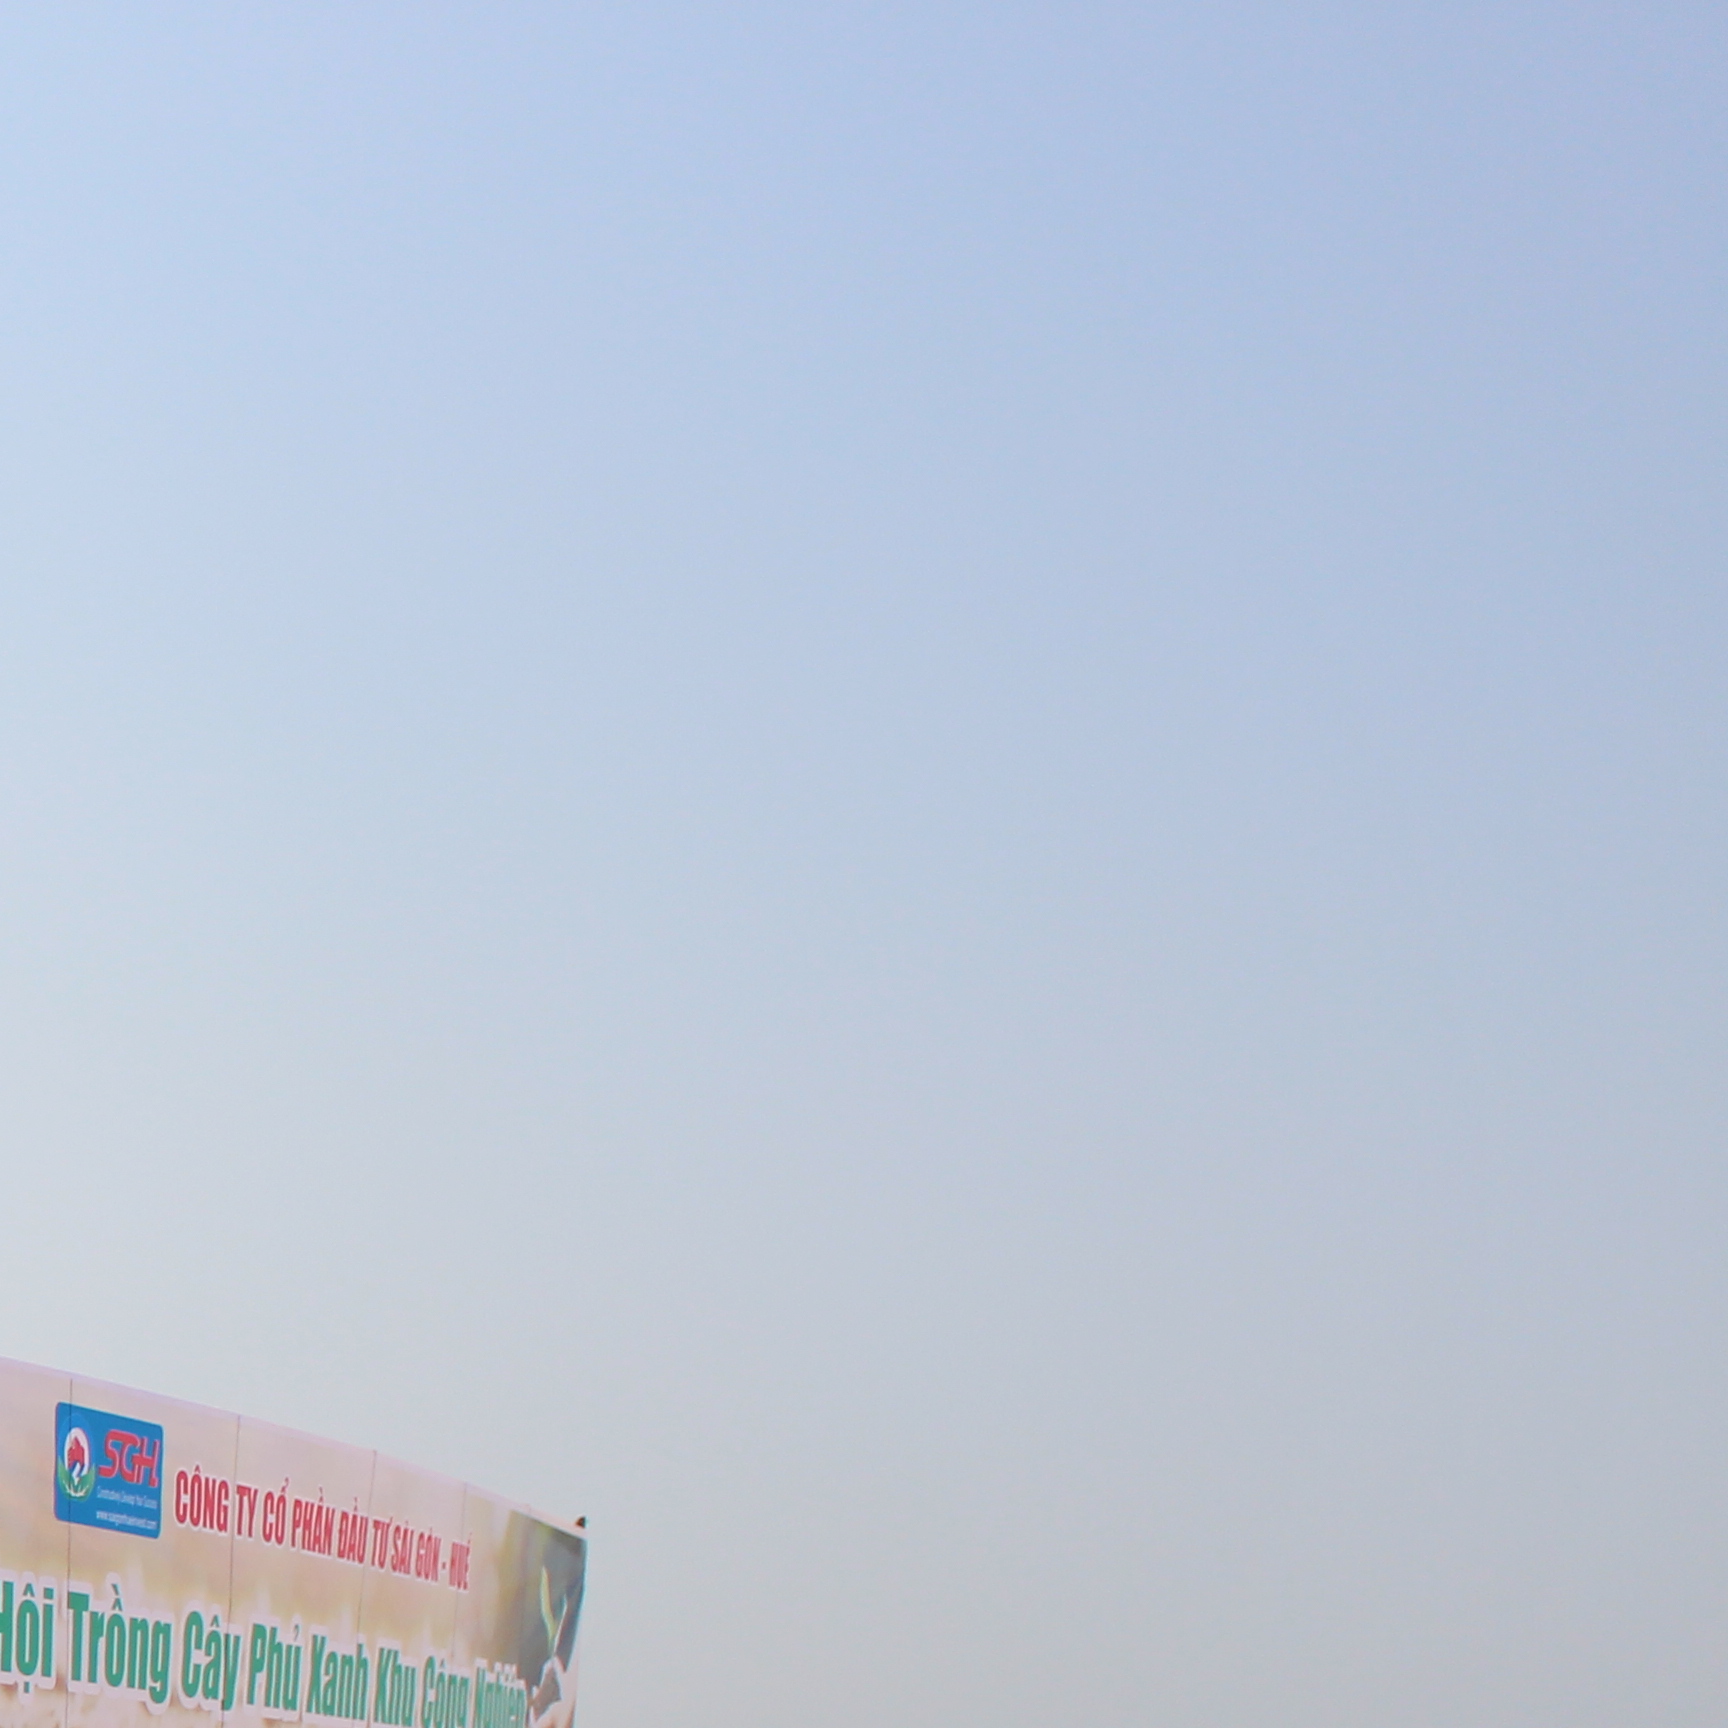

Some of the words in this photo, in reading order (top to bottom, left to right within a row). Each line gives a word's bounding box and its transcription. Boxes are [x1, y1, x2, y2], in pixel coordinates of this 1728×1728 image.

[175, 1465, 230, 1533] CÔNG
[236, 1484, 259, 1538] TY
[262, 1477, 290, 1546] CỔ
[291, 1486, 336, 1556] PHẦN
[337, 1497, 369, 1564] ĐẦU
[371, 1516, 393, 1570] TƯ
[391, 1520, 415, 1575] SÀI
[415, 1527, 442, 1582] GÒN
[66, 1583, 173, 1704] Trồng
[181, 1610, 242, 1712] Cây
[246, 1622, 303, 1712] Phủ
[305, 1633, 369, 1721] Xanh
[373, 1646, 418, 1728] Khu
